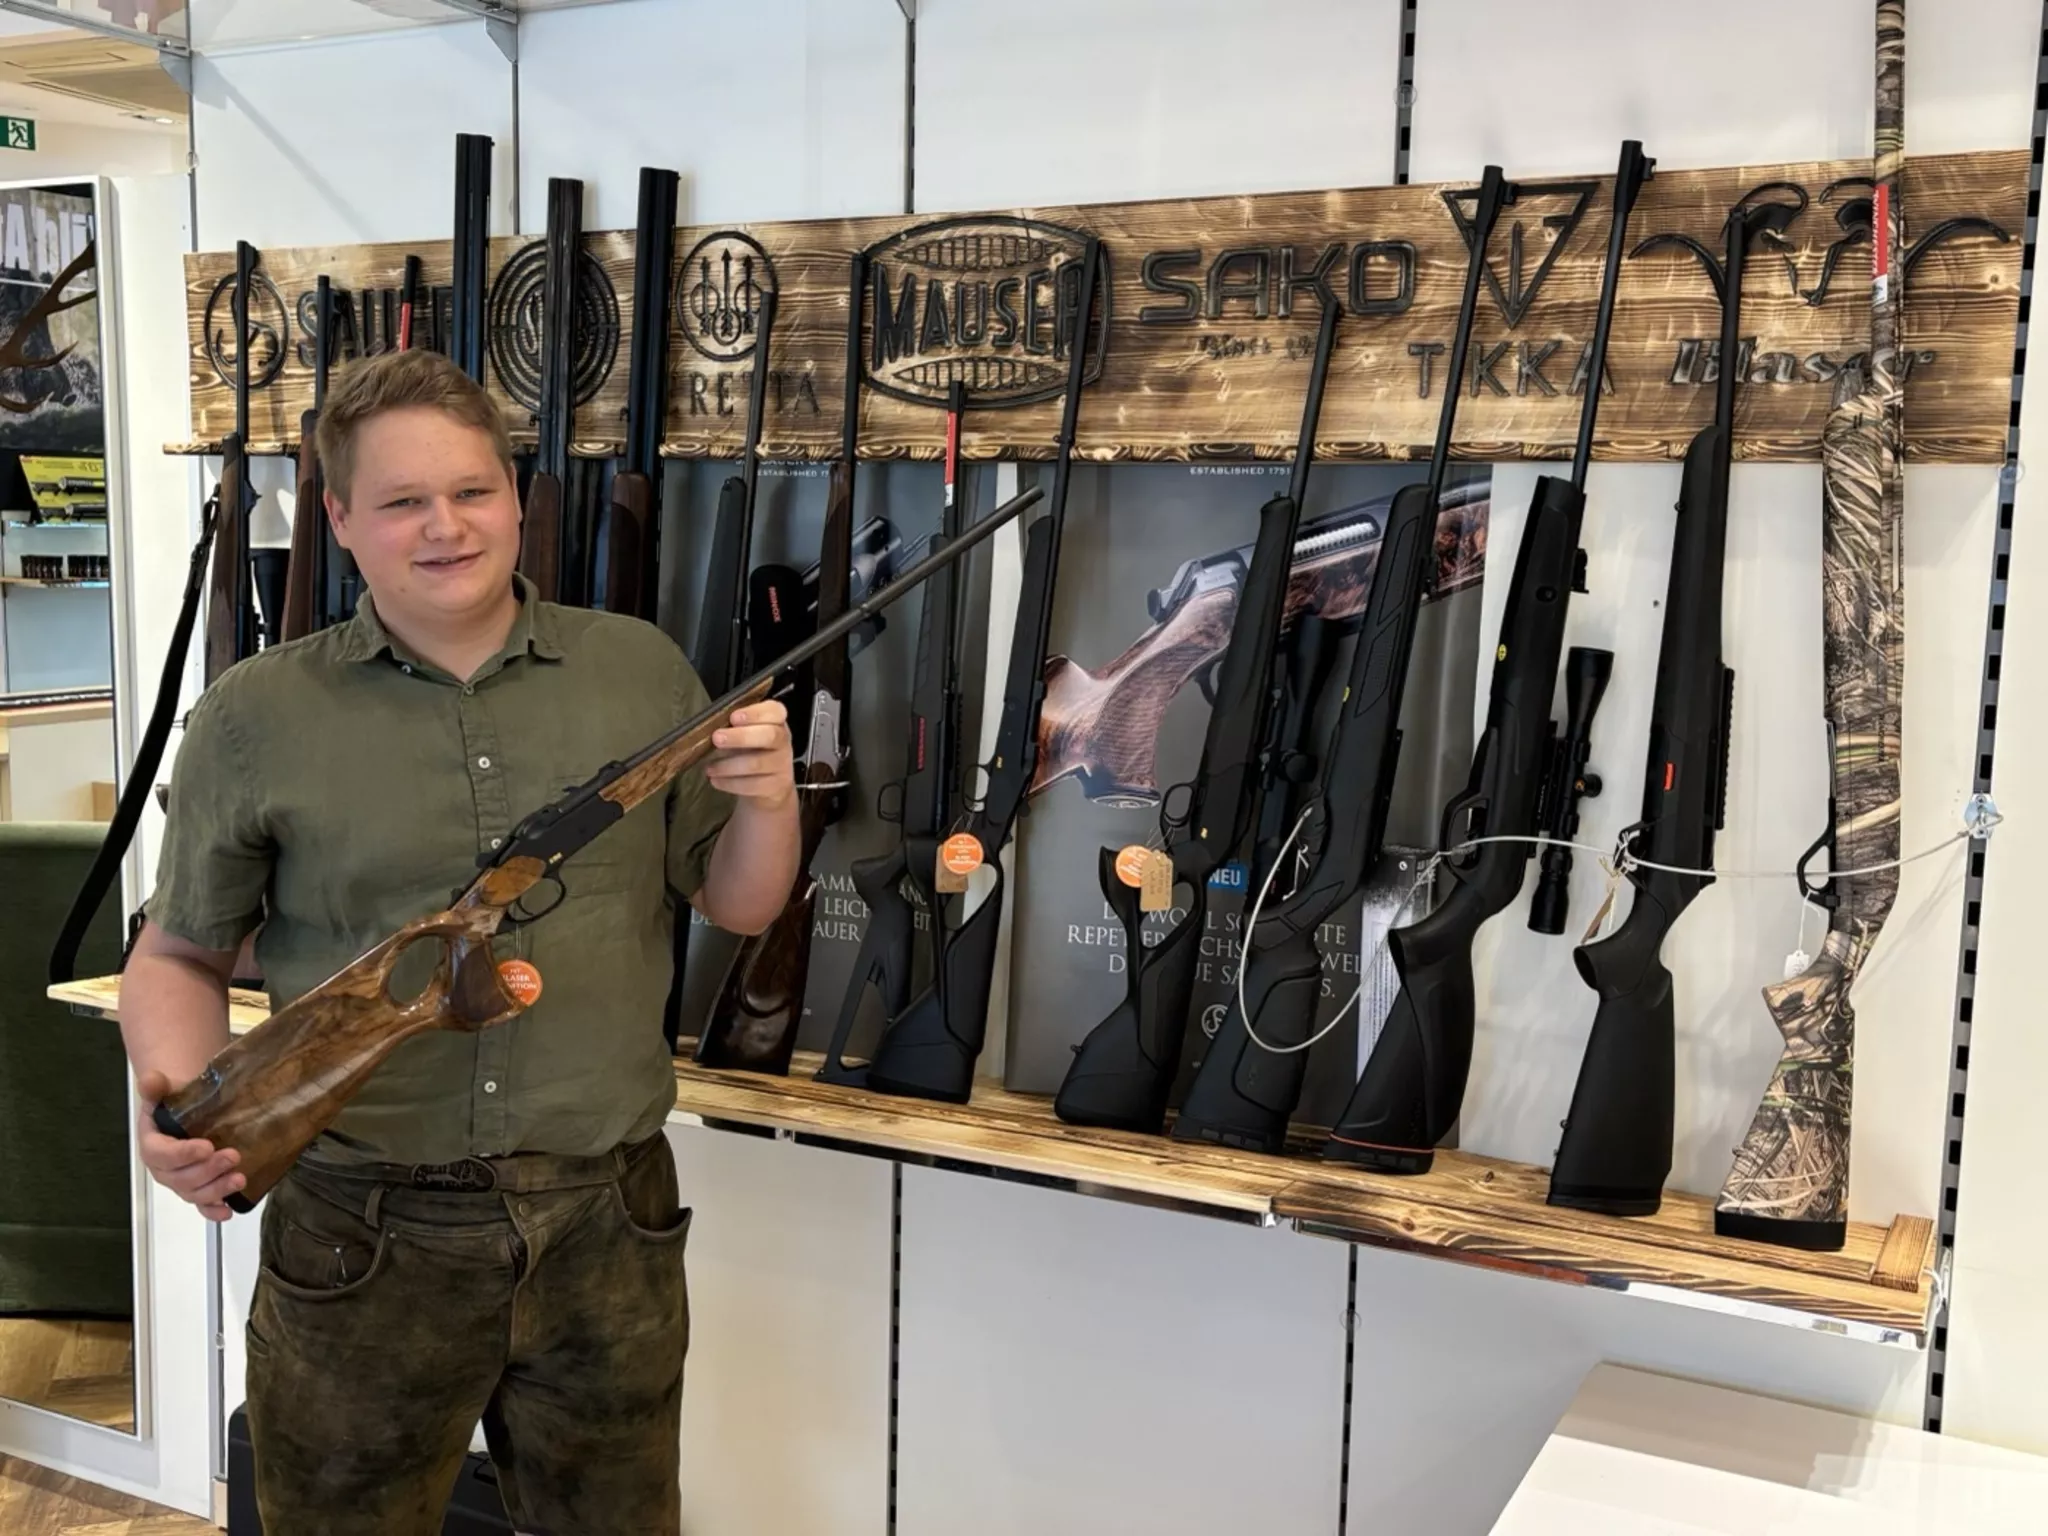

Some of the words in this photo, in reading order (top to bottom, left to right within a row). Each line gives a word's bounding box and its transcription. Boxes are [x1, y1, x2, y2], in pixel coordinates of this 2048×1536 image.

[1139, 240, 1416, 323] SAKO
[1408, 340, 1616, 399] TKKA
[757, 469, 818, 477] ESTABLISHED
[1189, 466, 1265, 475] ESTABLISHED
[768, 586, 782, 623] MINOX
[812, 922, 861, 942] AUER
